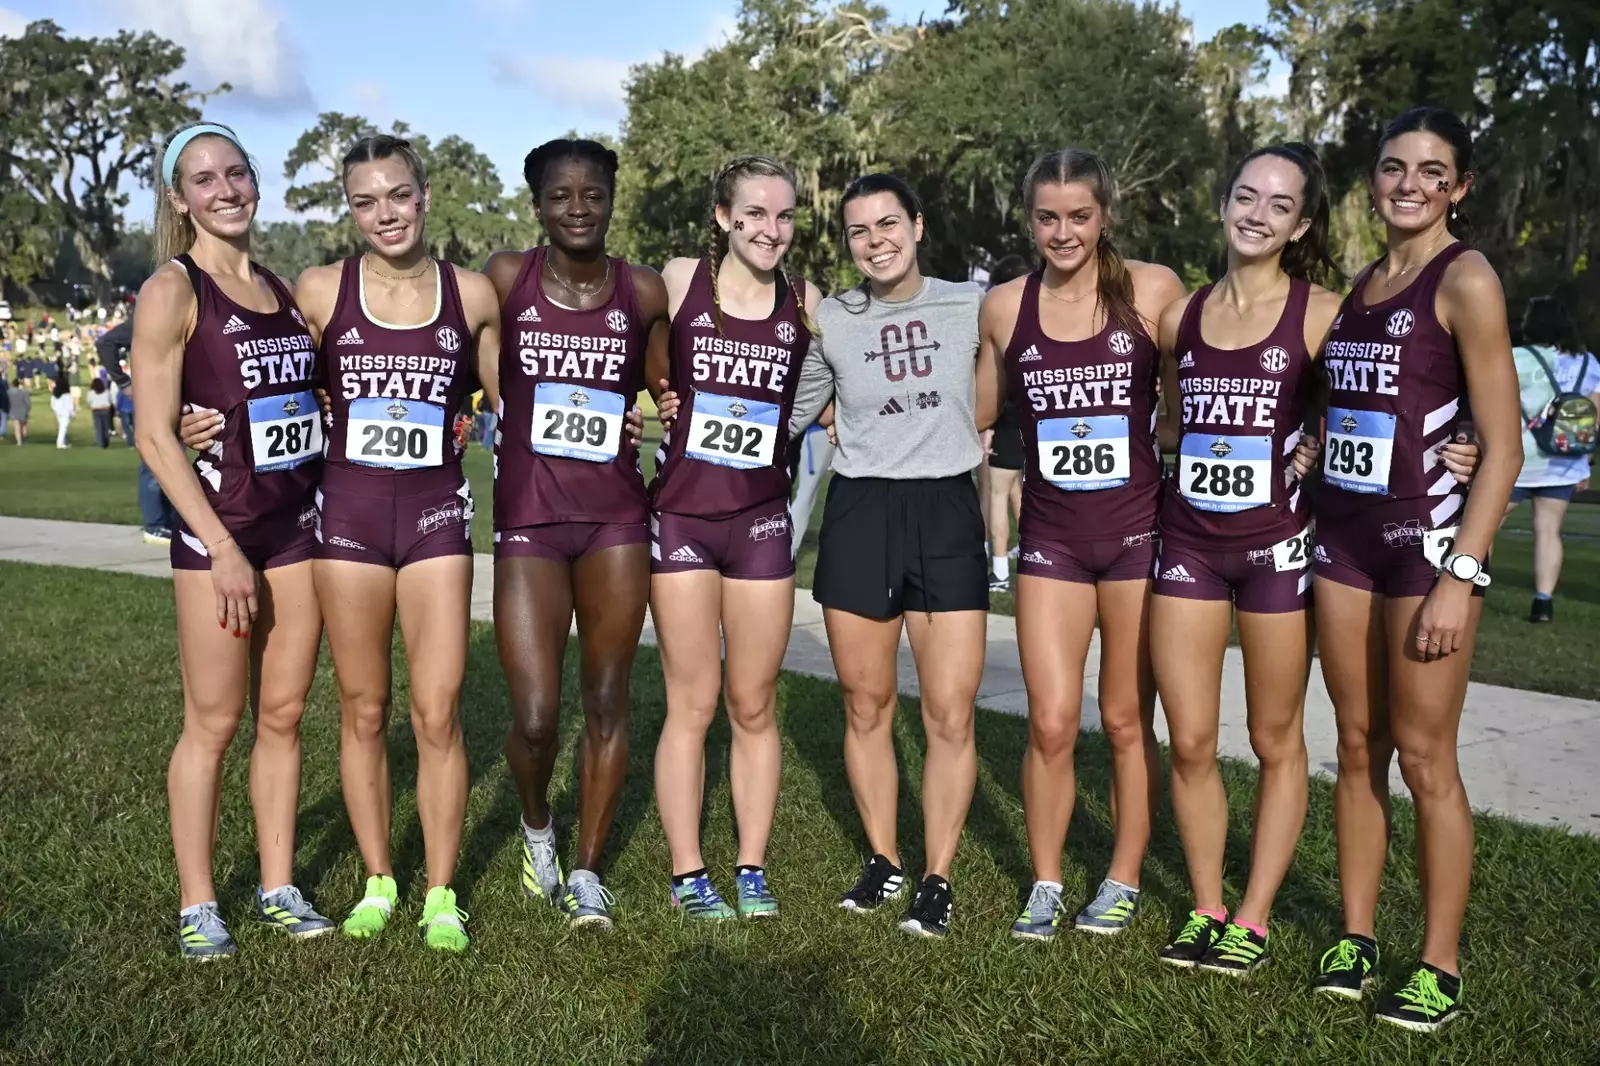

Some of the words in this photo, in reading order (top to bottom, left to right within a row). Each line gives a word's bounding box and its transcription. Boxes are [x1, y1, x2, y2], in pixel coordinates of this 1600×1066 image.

[223, 324, 251, 335] adidas
[607, 310, 628, 332] SEC
[690, 321, 715, 329] adidas
[777, 322, 795, 343] SEC
[1386, 309, 1414, 336] SEC
[234, 335, 314, 359] MISSISSIP
[437, 327, 460, 351] SEC
[519, 331, 626, 353] MISSISSIPPI
[692, 336, 791, 364] MISSISSIPPI
[880, 320, 932, 382] CC
[1109, 331, 1133, 354] SEC
[339, 355, 456, 375] MISSISSIPPI
[520, 348, 626, 381] STATE
[692, 353, 789, 393] STATE
[1262, 348, 1287, 372] SEC
[1023, 362, 1133, 387] MISSISSIPPI
[1180, 377, 1282, 396] MISSISSIPPI
[1325, 359, 1400, 396] TATE
[341, 372, 452, 404] STATE
[1027, 379, 1132, 412] STATE
[1182, 395, 1277, 428] STATE
[266, 419, 313, 458] 287
[543, 409, 607, 447] 289
[700, 420, 763, 457] 292
[361, 425, 428, 459] 290
[1052, 444, 1115, 476] 286
[1329, 438, 1373, 477] 293
[1190, 462, 1254, 497] 288
[756, 520, 786, 534] STATE
[1389, 528, 1422, 540] STATE
[669, 554, 703, 563] adidas
[1286, 529, 1315, 563] 28
[1023, 555, 1053, 566] adidas
[1162, 574, 1196, 583] adidas
